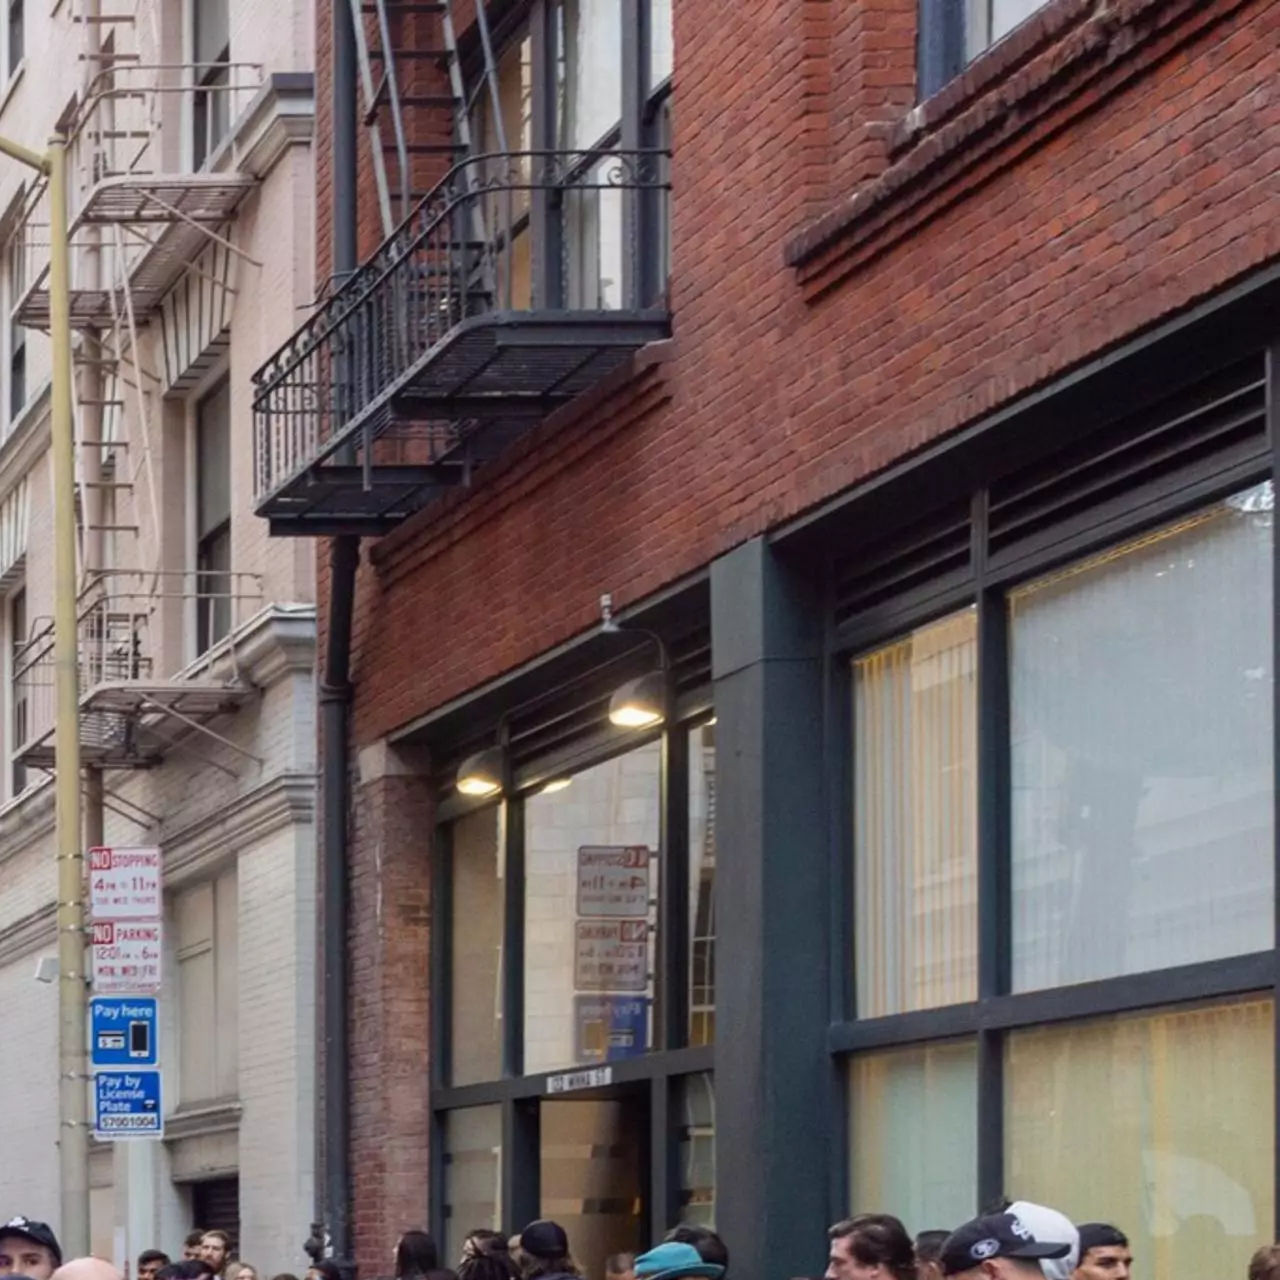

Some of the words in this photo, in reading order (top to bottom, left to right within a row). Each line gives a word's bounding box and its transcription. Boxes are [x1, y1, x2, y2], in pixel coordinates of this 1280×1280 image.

[91, 850, 110, 869] NO
[112, 854, 157, 867] STOPPING
[94, 925, 111, 941] NO
[117, 928, 158, 941] PARKING
[95, 1004, 119, 1020] Pay
[121, 1004, 153, 1018] here
[98, 1075, 122, 1089] Pay
[124, 1075, 141, 1089] by
[99, 1088, 145, 1099] License
[100, 1100, 131, 1112] Plate
